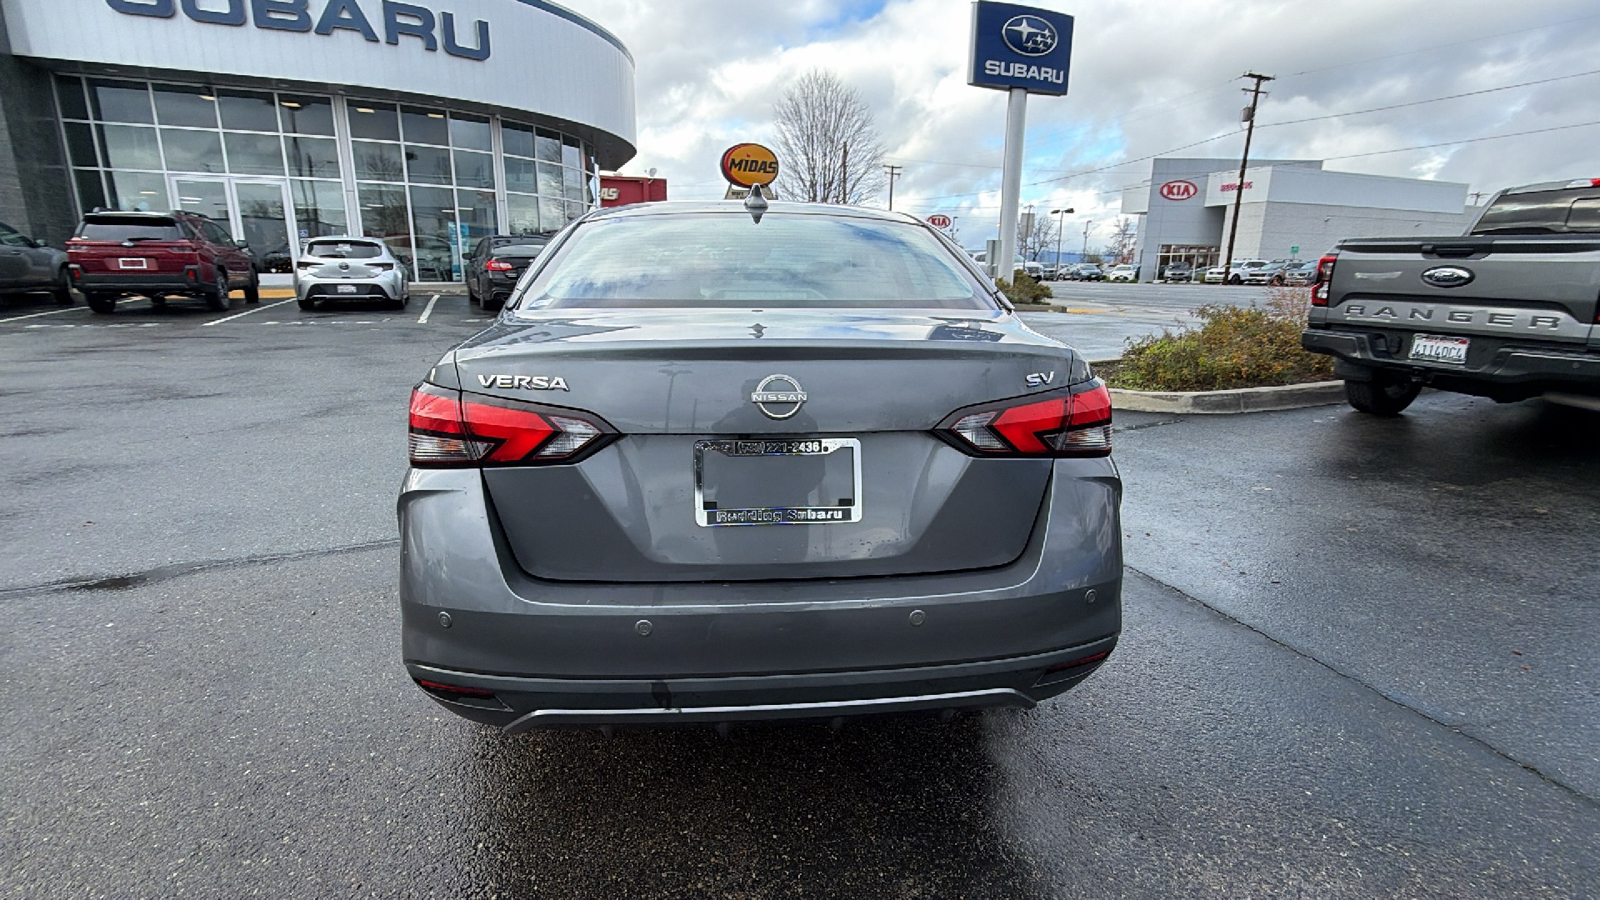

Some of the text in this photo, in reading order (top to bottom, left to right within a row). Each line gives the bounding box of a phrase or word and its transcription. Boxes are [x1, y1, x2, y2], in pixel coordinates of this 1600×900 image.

[984, 60, 1064, 84] SUBARU
[729, 158, 778, 174] MIDAS
[1166, 184, 1191, 196] KIA
[931, 217, 947, 227] KIA
[1344, 304, 1562, 331] RANGER
[477, 374, 570, 392] VERSA
[1025, 370, 1055, 388] SV
[752, 393, 807, 401] NISSAN
[787, 509, 843, 521] Subaru
